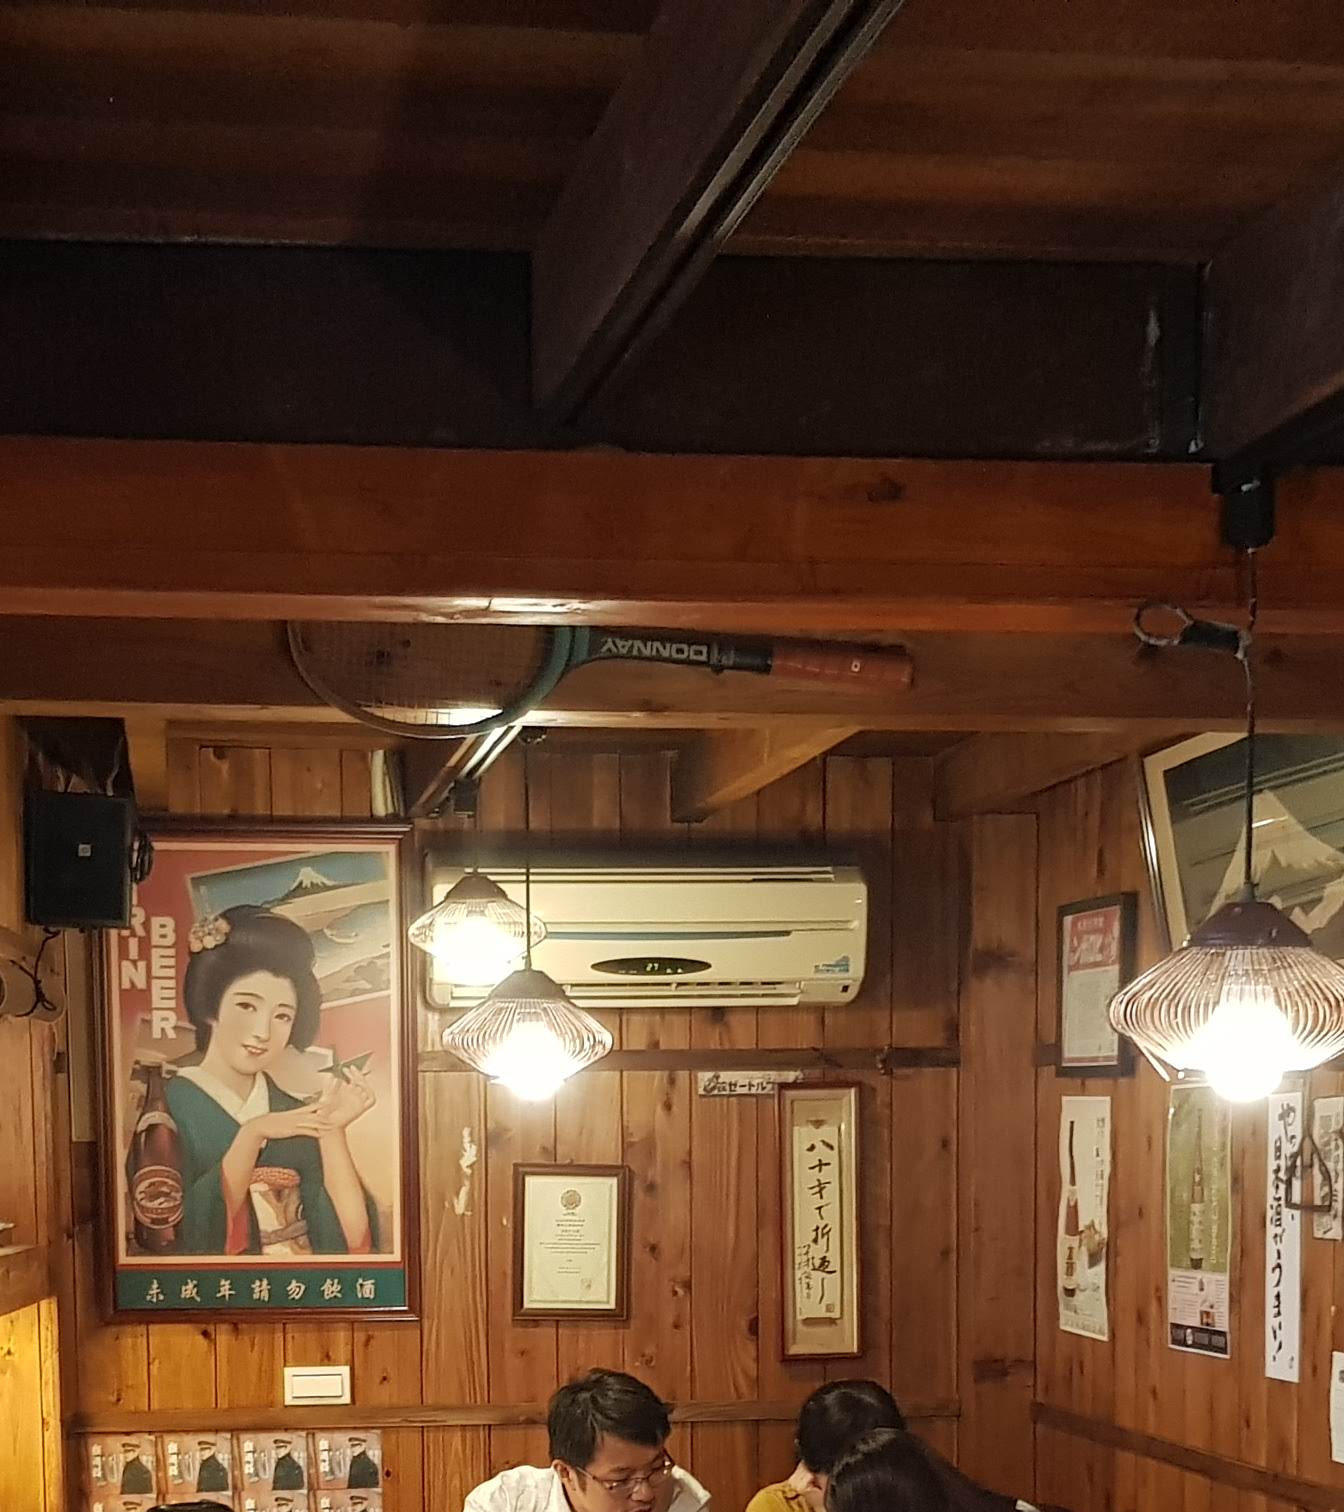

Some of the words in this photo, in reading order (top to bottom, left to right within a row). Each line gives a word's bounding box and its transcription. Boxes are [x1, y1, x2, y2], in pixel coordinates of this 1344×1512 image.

[601, 637, 709, 662] DONNAY
[120, 882, 147, 990] IRIN
[150, 916, 177, 1039] BEER
[145, 1277, 377, 1303] 未成年請勿飲酒
